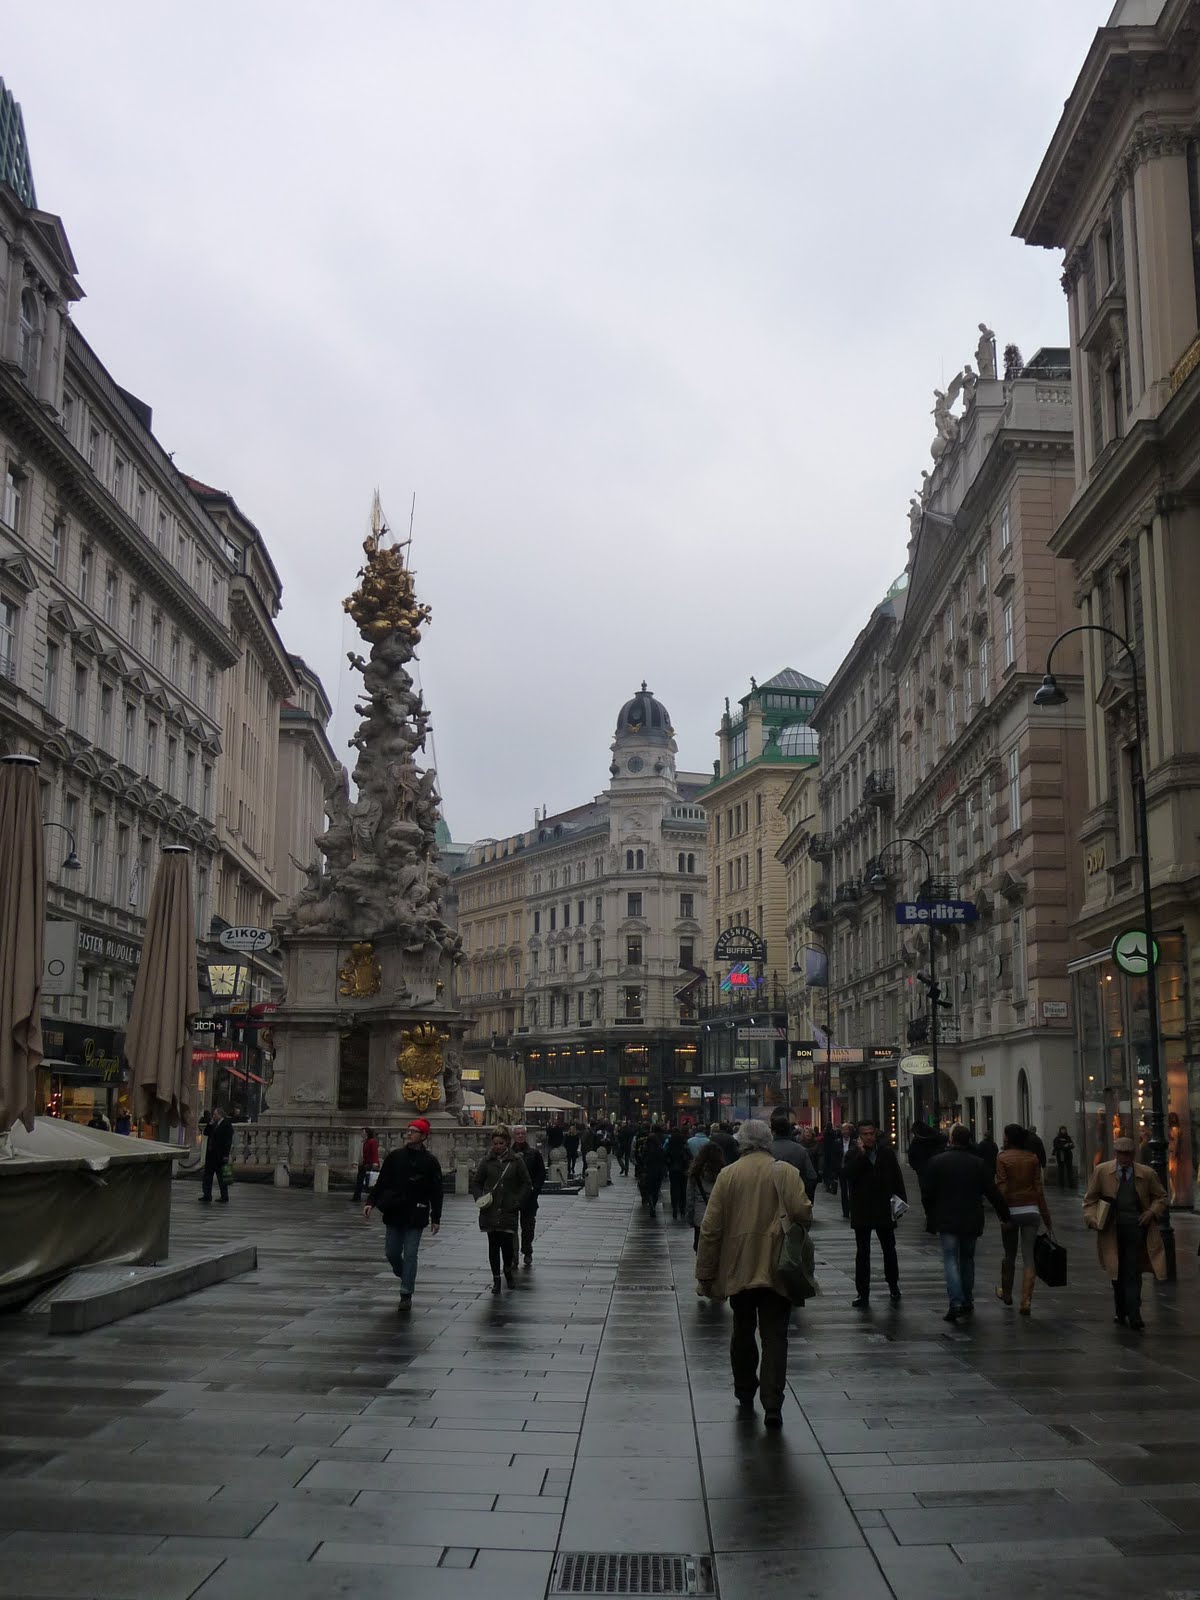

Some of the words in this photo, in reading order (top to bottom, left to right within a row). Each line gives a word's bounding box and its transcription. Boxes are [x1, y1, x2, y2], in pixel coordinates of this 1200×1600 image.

[905, 904, 965, 920] Berlitz
[226, 929, 266, 940] ZIKOS
[726, 946, 754, 954] BUFFET
